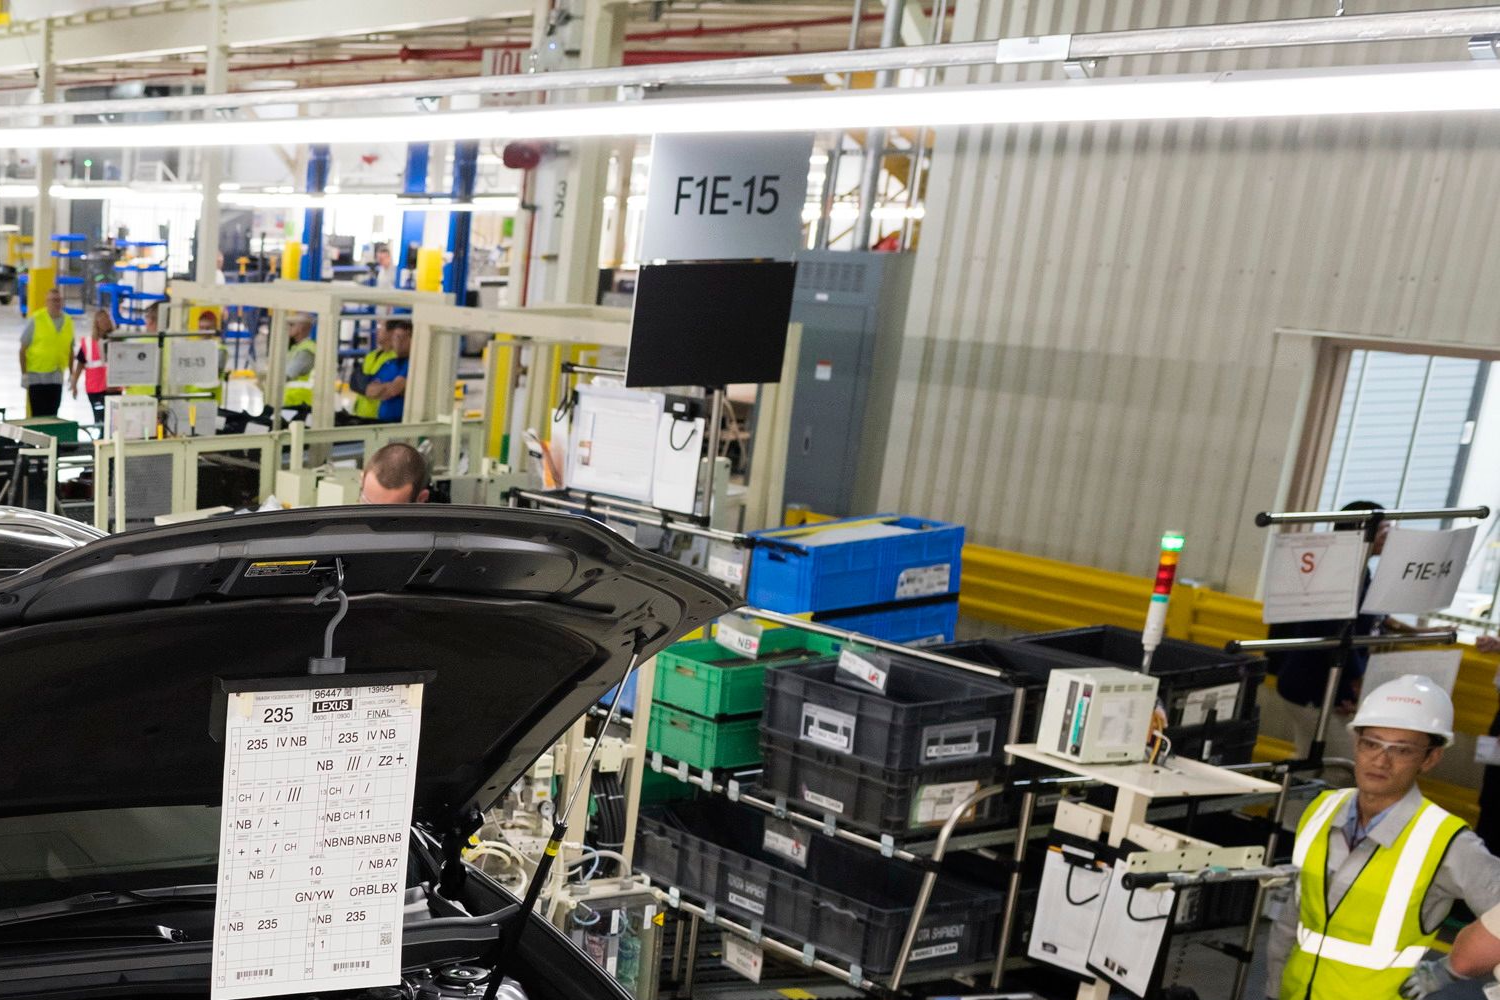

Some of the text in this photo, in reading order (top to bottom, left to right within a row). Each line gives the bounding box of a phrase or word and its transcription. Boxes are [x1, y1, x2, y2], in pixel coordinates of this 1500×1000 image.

[674, 174, 780, 217] F1E-15
[1402, 560, 1452, 580] F1E-14
[737, 636, 753, 650] NB
[1387, 696, 1422, 705] TOYOTA
[264, 706, 294, 724] 235
[316, 700, 350, 712] LEXUS
[367, 710, 392, 718] FINAL
[247, 738, 268, 750] 235
[276, 737, 288, 748] IV
[290, 736, 307, 746] NB
[338, 732, 358, 744] 235
[367, 730, 378, 740] IV
[380, 729, 396, 740] NB
[316, 760, 334, 771] NB
[378, 756, 392, 766] Z2
[329, 787, 342, 796] CH
[236, 820, 252, 830] NB
[326, 812, 340, 822] NB
[343, 811, 356, 819] CH
[249, 870, 264, 880] NB
[295, 890, 334, 902] GN/YW
[228, 922, 244, 932] NB
[258, 918, 278, 930] 235
[317, 914, 332, 924] NB
[346, 911, 366, 922] 235
